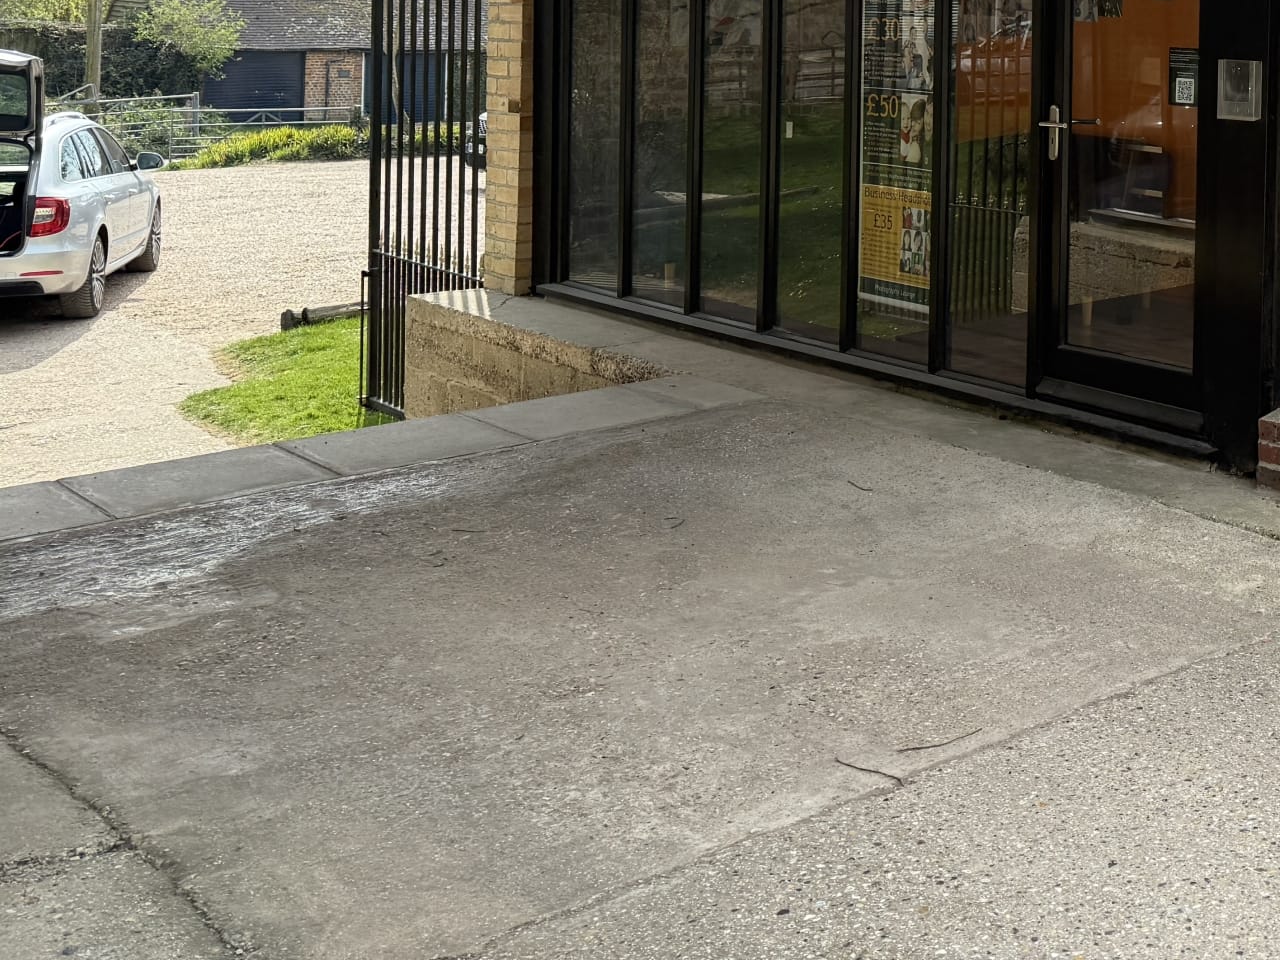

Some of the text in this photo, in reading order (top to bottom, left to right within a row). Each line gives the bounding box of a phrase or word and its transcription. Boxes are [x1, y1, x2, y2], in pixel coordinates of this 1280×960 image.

[866, 93, 898, 118] £50
[864, 187, 896, 201] Business
[873, 213, 893, 230] £35
